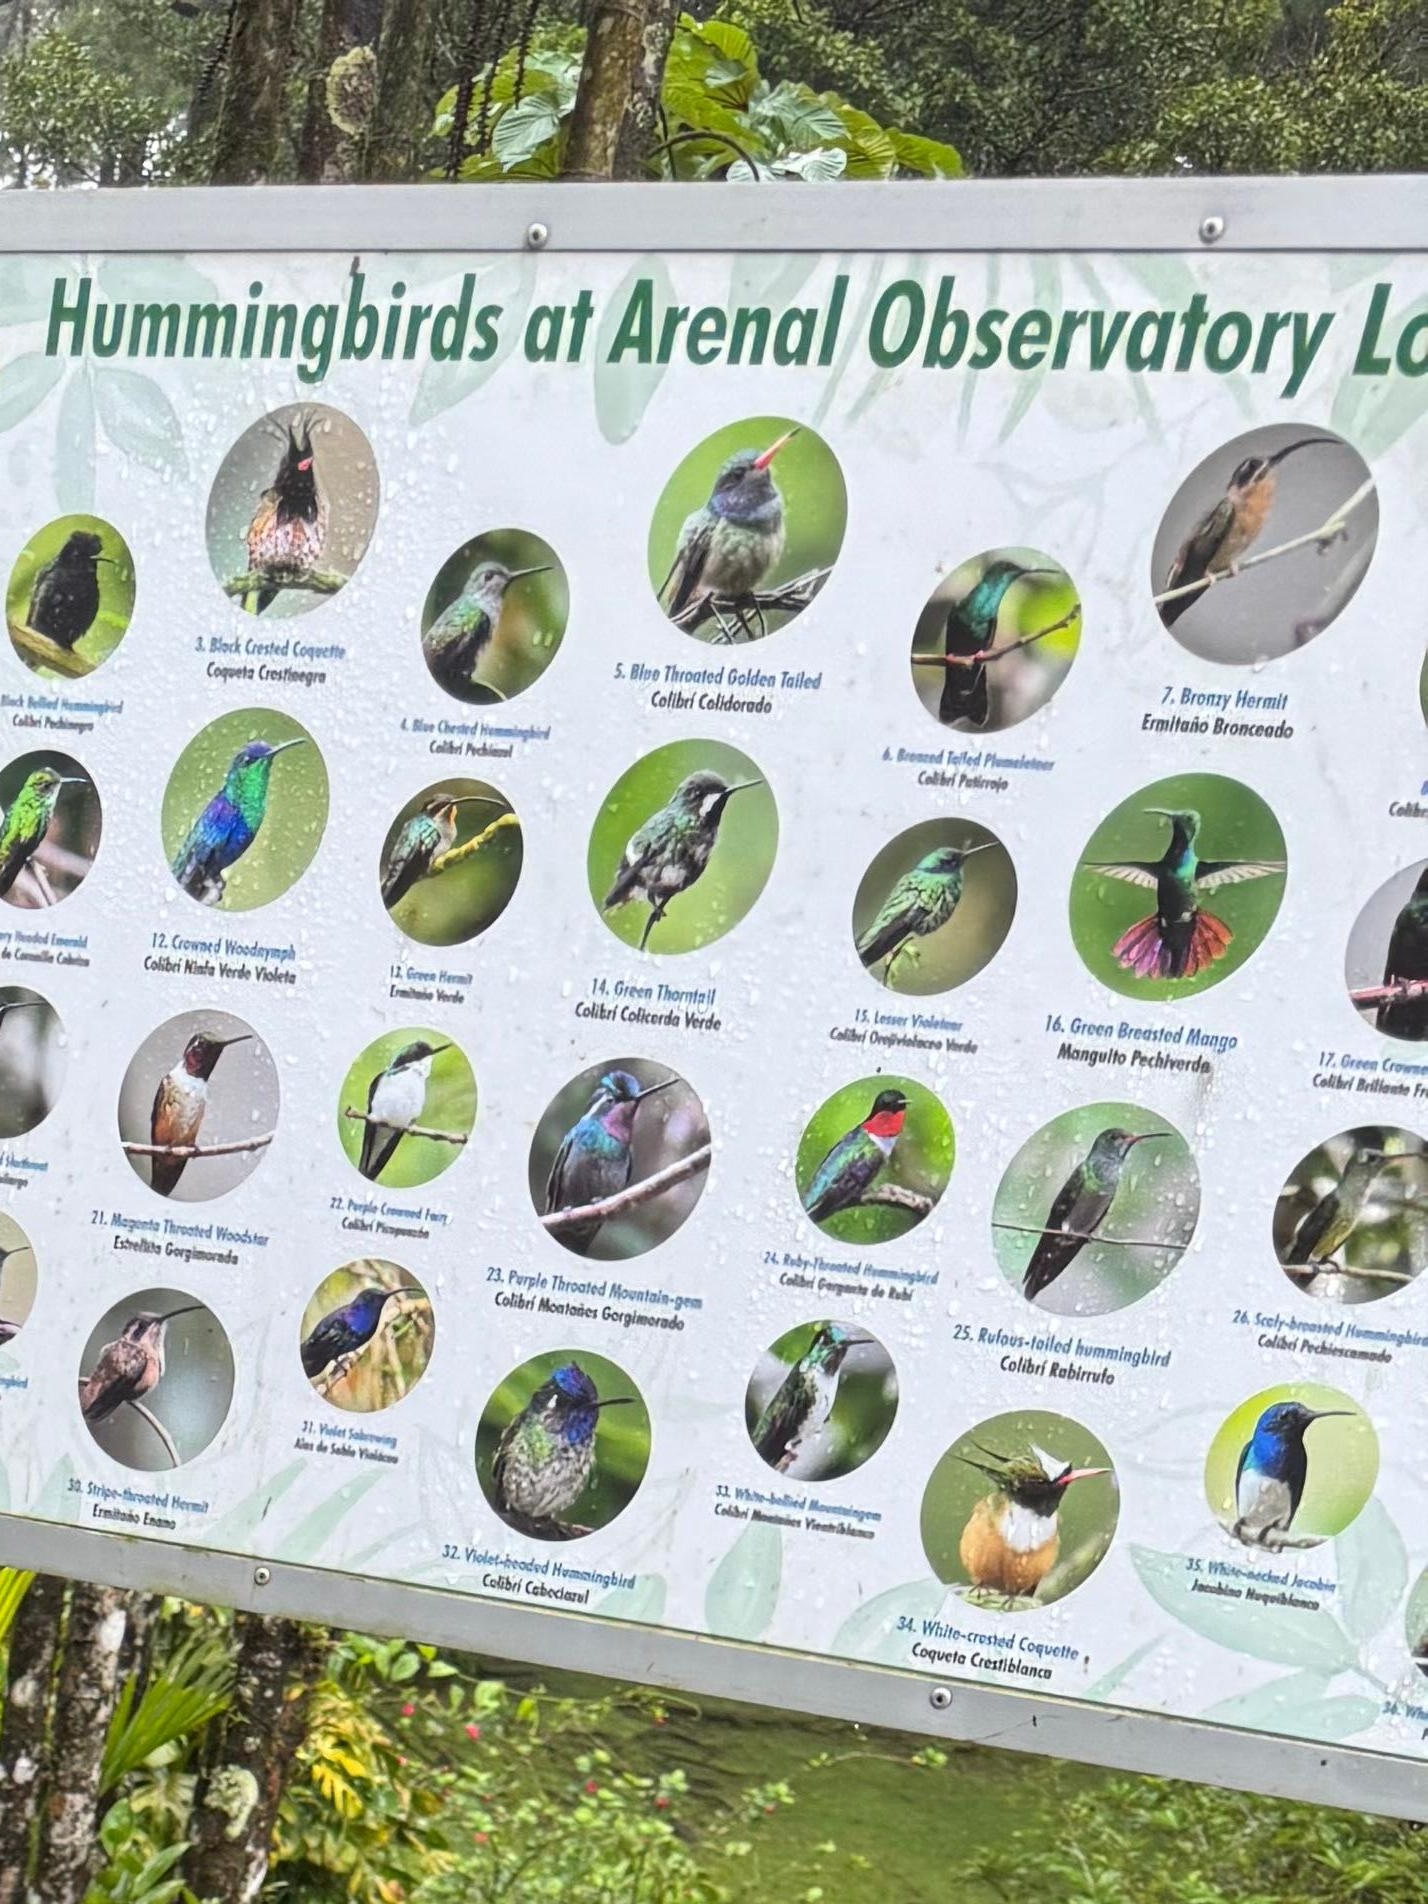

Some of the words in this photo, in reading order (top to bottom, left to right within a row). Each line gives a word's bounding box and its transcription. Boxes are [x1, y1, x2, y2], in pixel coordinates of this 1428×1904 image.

[44, 272, 504, 385] Hummingbirds
[523, 290, 594, 364] at
[607, 275, 850, 366] Arenal
[869, 276, 1336, 399] Observatory
[195, 637, 207, 652] 3.
[209, 638, 241, 655] Black
[245, 639, 289, 656] Crested
[293, 641, 345, 662] Coquette
[207, 662, 254, 680] Coqueta
[258, 665, 326, 687] Crestinegra
[614, 662, 626, 680] 5.
[630, 664, 660, 682] Blue
[665, 664, 724, 685] Throated
[728, 668, 776, 688] Golden
[781, 671, 822, 690] Tailed
[651, 691, 694, 710] Colibrí
[698, 692, 772, 715] Colidorado
[1161, 687, 1175, 704] 7.
[1180, 688, 1231, 711] Bronzy
[1235, 690, 1288, 710] Hermit
[1141, 714, 1209, 734] Ermitaño
[1213, 718, 1294, 739] Bronceado
[947, 751, 981, 766] Tailed
[918, 770, 955, 787] Colibrí
[1389, 802, 1428, 818] Colibr
[152, 932, 168, 949] 12.
[172, 935, 221, 955] Crowned
[225, 939, 296, 962] Woodnymph
[143, 956, 180, 973] Colibrí
[184, 958, 215, 977] Ninfa
[219, 962, 251, 981] Verde
[255, 966, 296, 985] Violeta
[591, 979, 609, 995] 14.
[614, 981, 653, 998] Green
[657, 984, 716, 1005] Thorntail
[575, 1002, 617, 1020] Colibrí
[620, 1006, 680, 1027] Colicerda
[684, 1012, 722, 1031] Verde
[874, 1011, 908, 1026] Lesser
[946, 1038, 978, 1055] Verde
[1045, 1015, 1065, 1033] 16.
[1071, 1018, 1113, 1037] Green
[1118, 1022, 1182, 1045] Breasted
[1185, 1028, 1238, 1054] Mango
[1057, 1044, 1126, 1068] Manguito
[1131, 1050, 1211, 1074] Pechiverde
[1319, 1051, 1337, 1067] 17.
[1341, 1054, 1378, 1070] Green
[1383, 1058, 1428, 1075] Crowne
[1313, 1074, 1354, 1090] Colibrí
[1357, 1078, 1410, 1096] Brillante
[92, 1211, 107, 1226] 21.
[111, 1213, 160, 1235] Magenta
[163, 1219, 213, 1240] Throated
[216, 1225, 269, 1248] Woodstar
[114, 1236, 162, 1254] Estrellita
[764, 1251, 779, 1264] 24.
[863, 1264, 940, 1285] Hummingbird
[486, 1267, 505, 1284] 23.
[508, 1270, 547, 1292] Purple
[551, 1275, 606, 1297] Throated
[610, 1282, 703, 1311] Mountain-gem
[871, 1285, 885, 1298] de
[494, 1292, 537, 1312] Colibrí
[601, 1307, 685, 1332] Gorgimorado
[1232, 1310, 1250, 1325] 26.
[1255, 1312, 1344, 1335] Scaly-breasted
[953, 1324, 974, 1341] 25.
[978, 1327, 1071, 1356] Rufous-tailed
[1075, 1342, 1171, 1369] hummingbird
[1258, 1334, 1298, 1351] Colibrí
[1300, 1337, 1393, 1363] Pechiescamado
[1000, 1356, 1046, 1376] Colibrí
[1049, 1362, 1115, 1385] Rabirrufo
[68, 1478, 83, 1493] 30.
[442, 1545, 461, 1560] 32.
[465, 1548, 549, 1575] Violet-headed
[552, 1562, 636, 1591] Hummingbird
[1186, 1558, 1204, 1571] 35.
[482, 1574, 522, 1594] Colibrí
[897, 1617, 917, 1634] 34.
[922, 1620, 1015, 1649] White-crested
[1018, 1636, 1079, 1662] Coquette
[912, 1643, 966, 1665] Coqueta
[971, 1652, 1053, 1680] Crestiblanca
